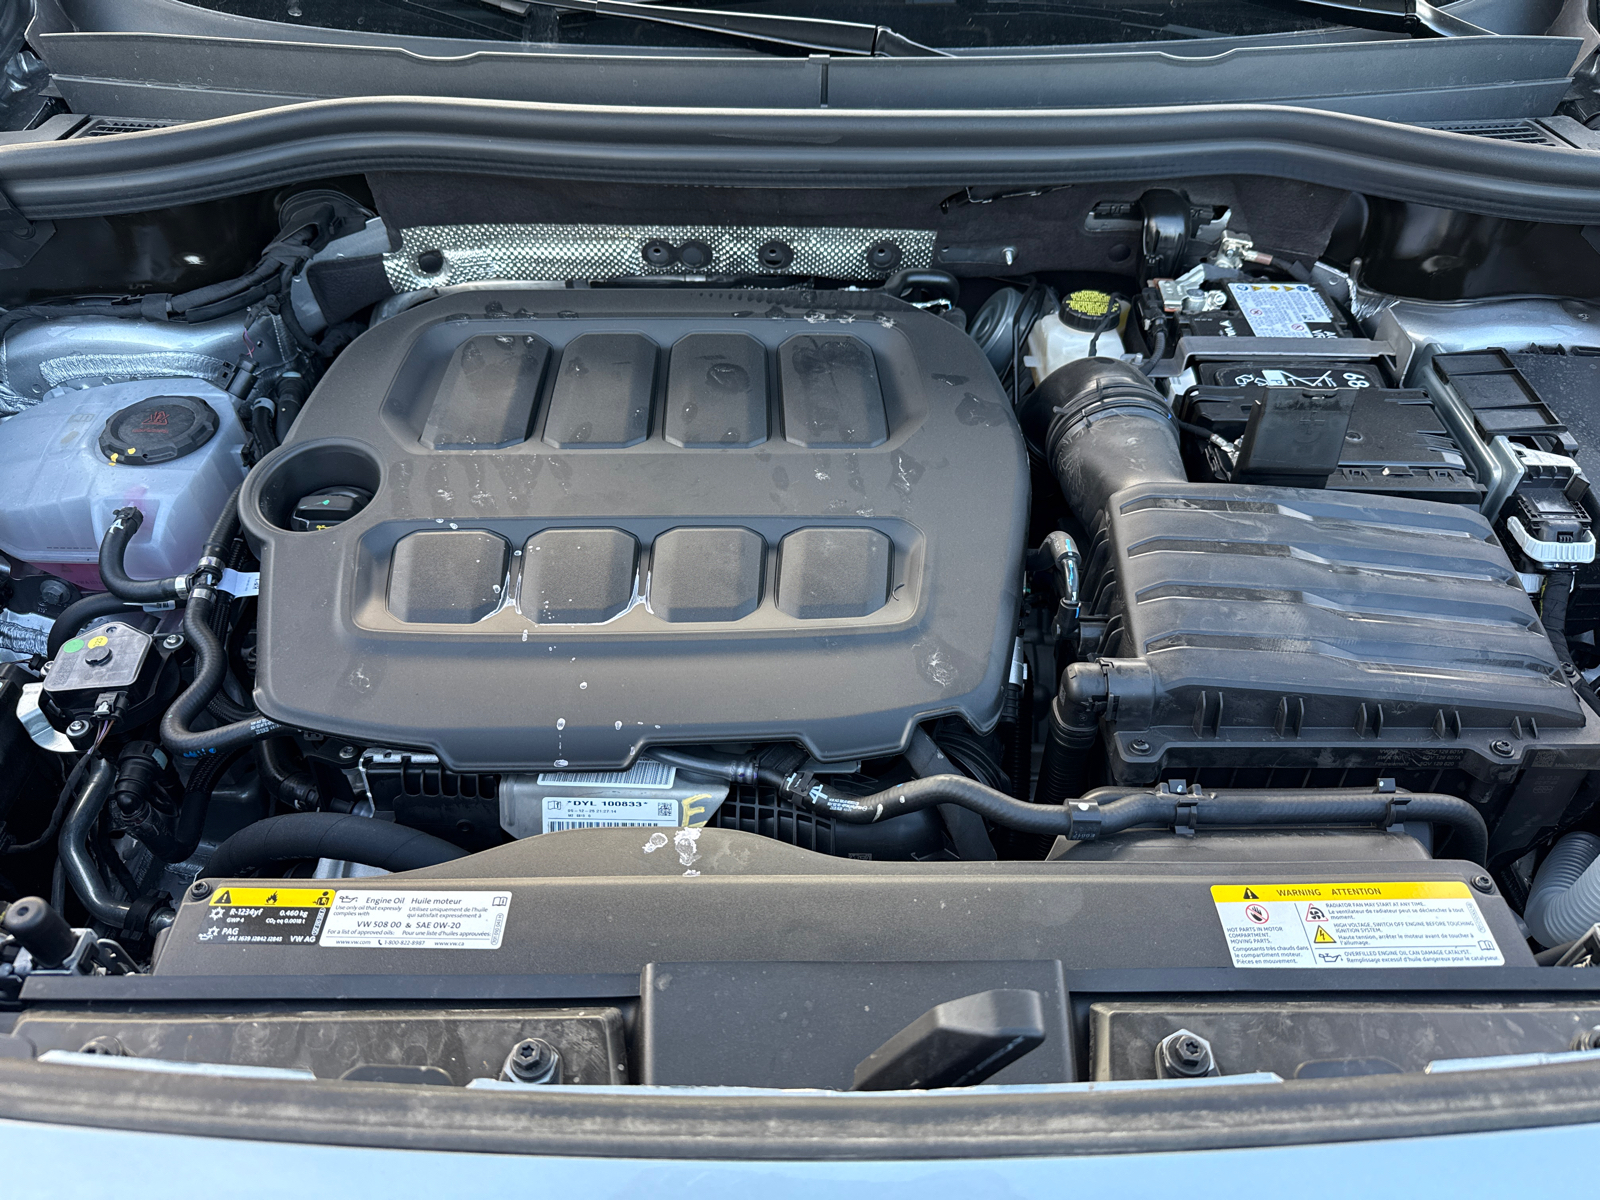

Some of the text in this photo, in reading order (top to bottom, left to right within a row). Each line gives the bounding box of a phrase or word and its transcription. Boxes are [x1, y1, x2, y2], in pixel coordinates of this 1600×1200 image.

[1342, 372, 1370, 388] 68
[229, 908, 263, 918] R-1234yf
[300, 910, 308, 918] kg
